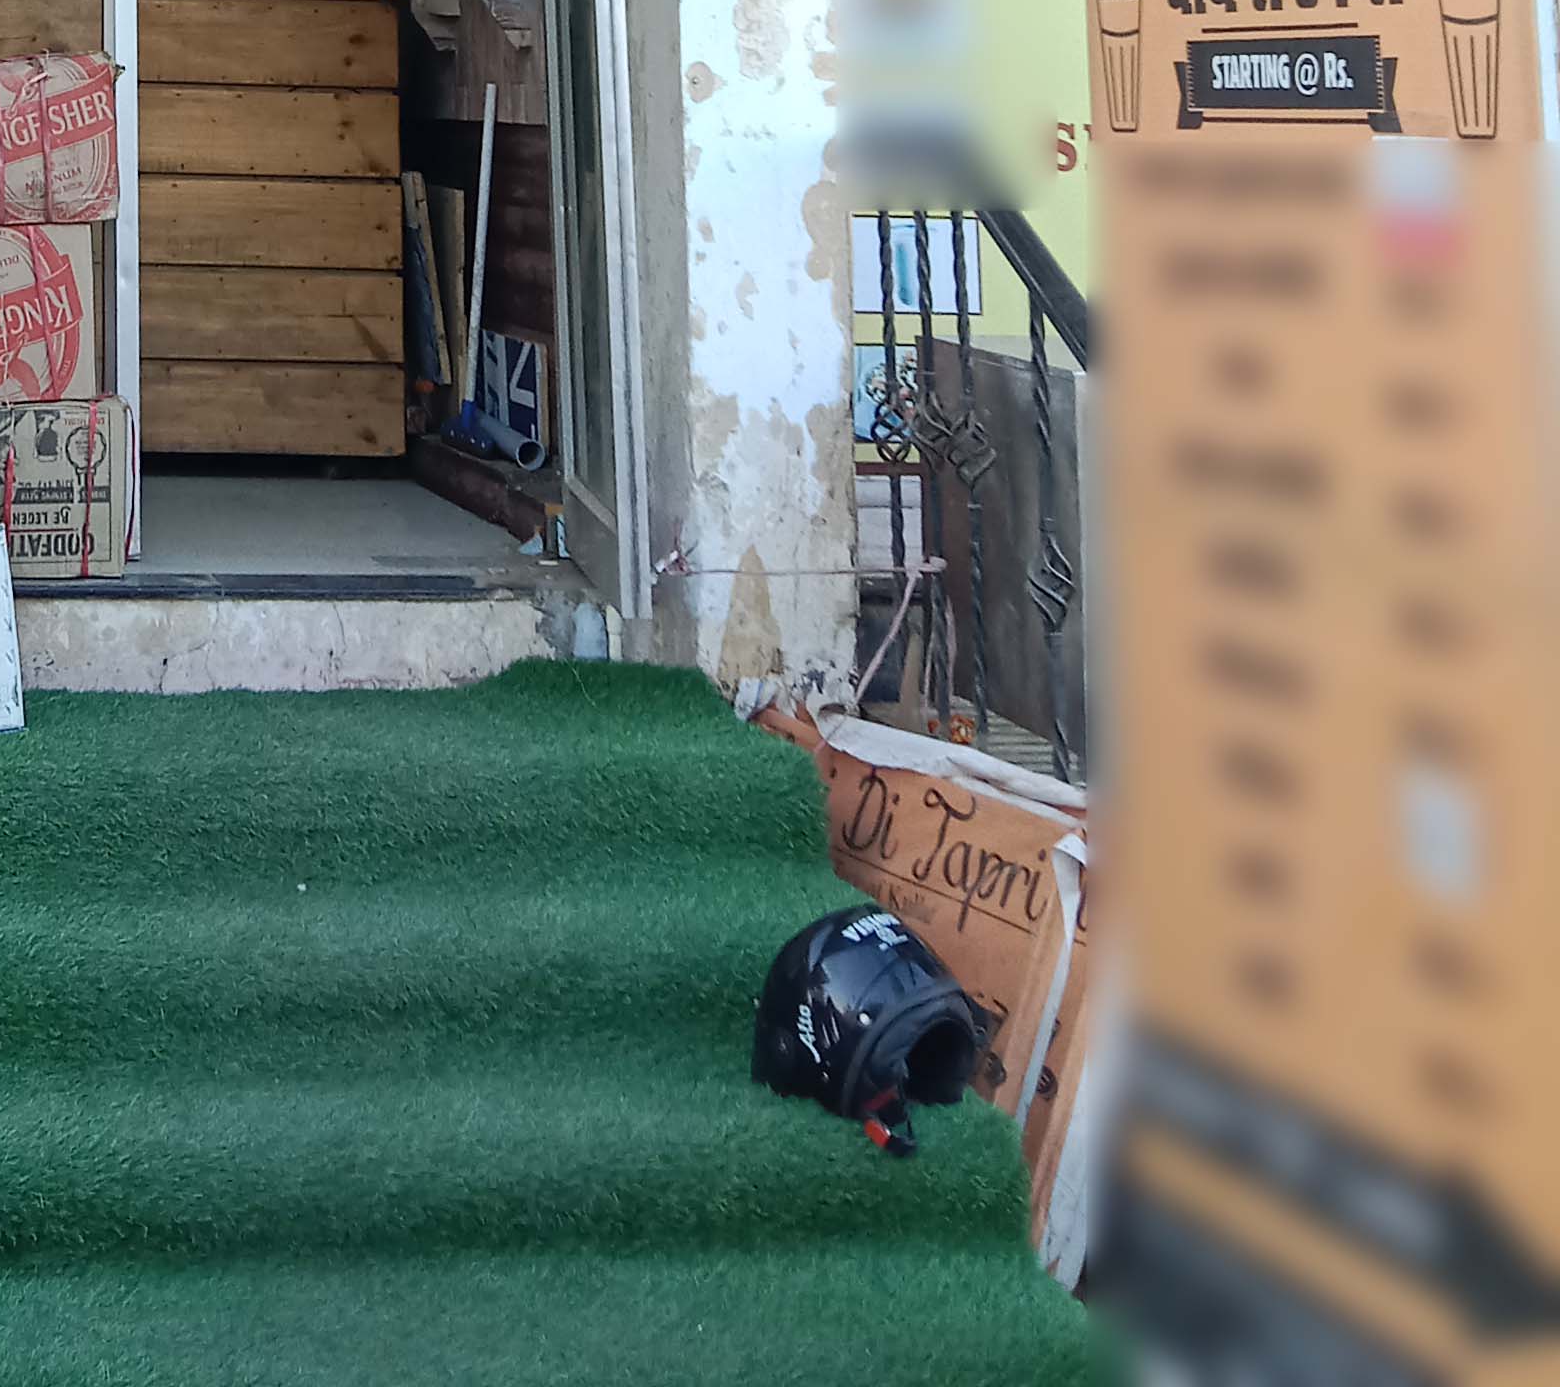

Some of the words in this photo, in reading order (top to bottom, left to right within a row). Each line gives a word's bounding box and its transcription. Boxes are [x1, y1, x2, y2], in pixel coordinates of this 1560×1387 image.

[1211, 52, 1291, 91] STARTING
[1294, 52, 1321, 96] @
[1324, 53, 1354, 90] Rs.
[842, 766, 900, 861] Di
[911, 787, 1048, 933] Tapri
